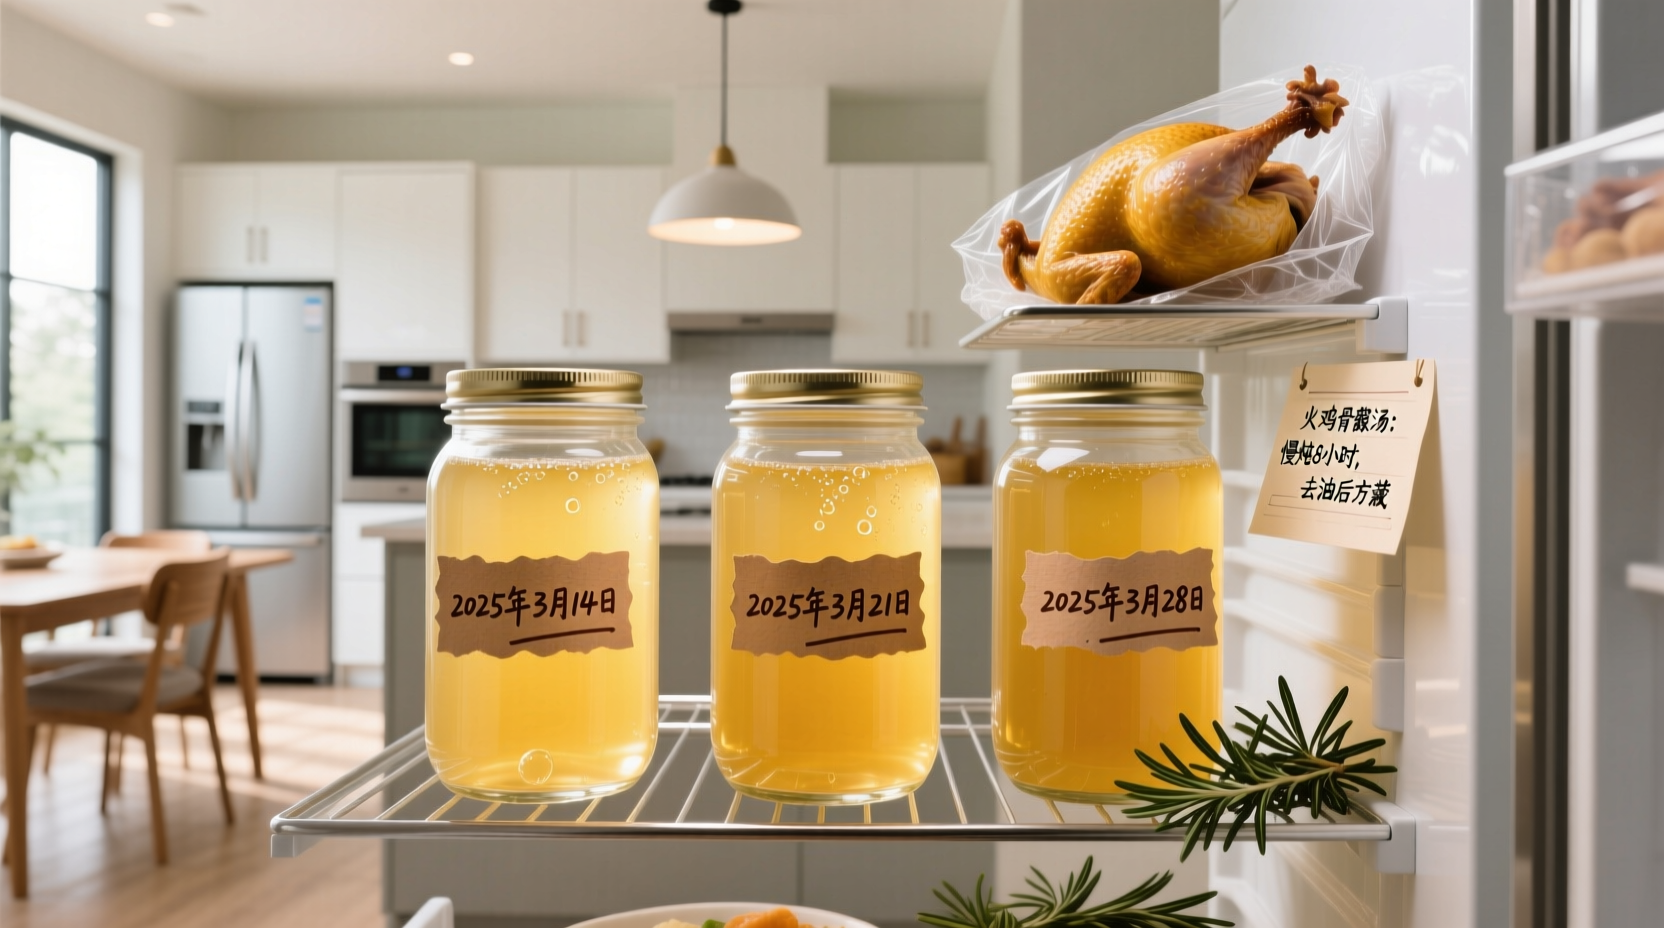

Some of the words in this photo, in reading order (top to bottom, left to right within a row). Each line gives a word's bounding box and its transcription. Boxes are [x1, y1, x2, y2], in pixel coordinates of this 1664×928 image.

[450, 585, 616, 627] 2025年3月14日
[746, 586, 910, 629] 2025年3月21日
[1040, 581, 1204, 622] 2025年3月28日
